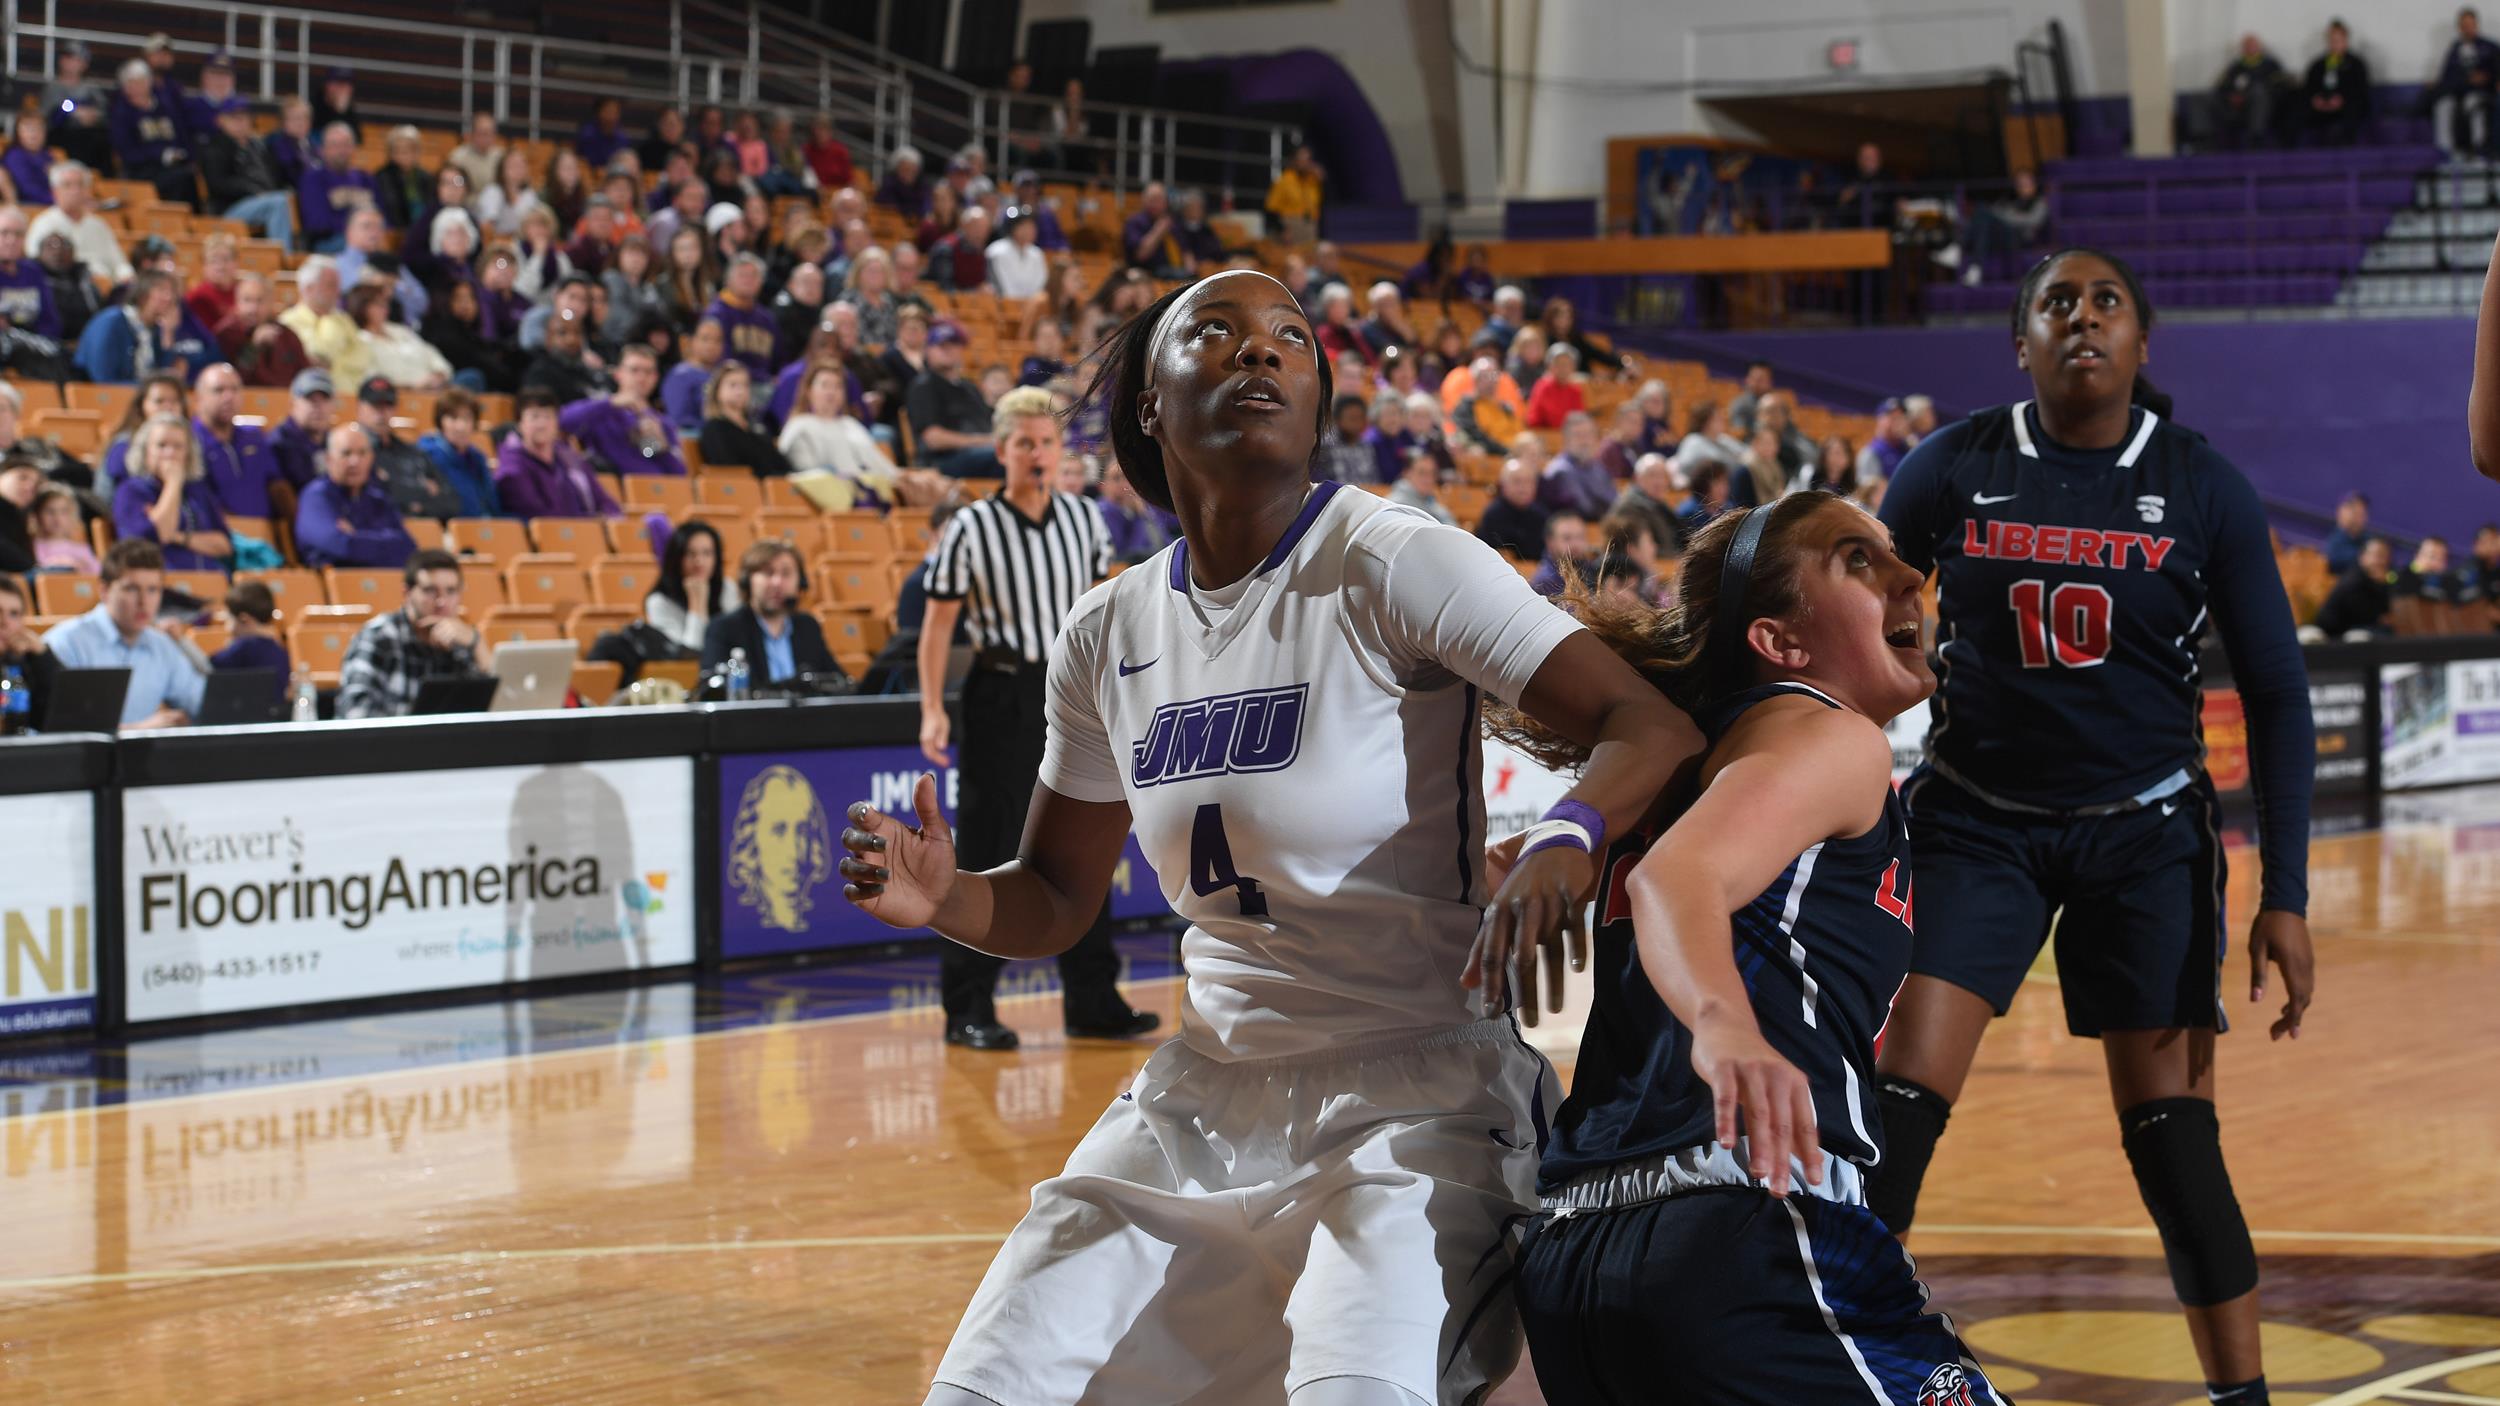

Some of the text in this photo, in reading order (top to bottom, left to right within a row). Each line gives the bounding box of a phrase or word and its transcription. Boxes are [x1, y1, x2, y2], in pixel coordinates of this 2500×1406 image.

[1963, 518, 2176, 572] LIBERTY
[2008, 578, 2114, 669] 10
[1131, 682, 1310, 790] JMU
[141, 816, 305, 866] Weaver's
[1190, 803, 1270, 917] 4
[140, 845, 601, 933] FlooringAmerica
[142, 951, 322, 990] (540)-433-1517
